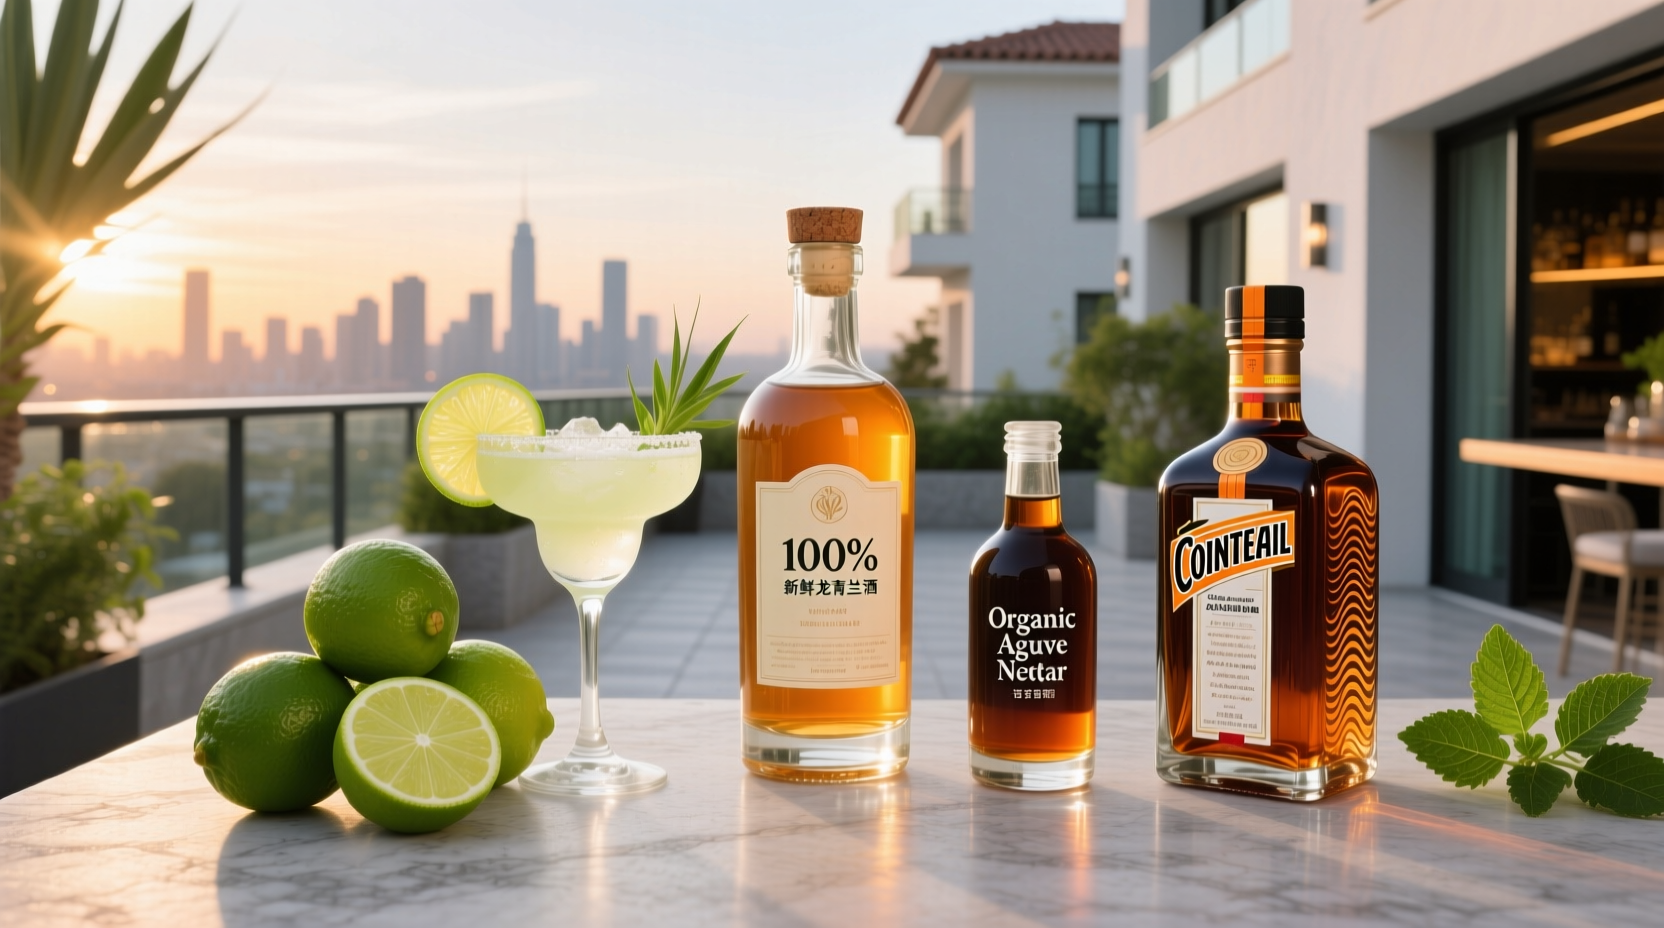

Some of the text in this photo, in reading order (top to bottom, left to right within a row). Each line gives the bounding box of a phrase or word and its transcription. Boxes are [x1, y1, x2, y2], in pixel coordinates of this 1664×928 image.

[782, 537, 878, 572] 100%
[988, 606, 1076, 636] Organic
[997, 633, 1068, 661] Aguve
